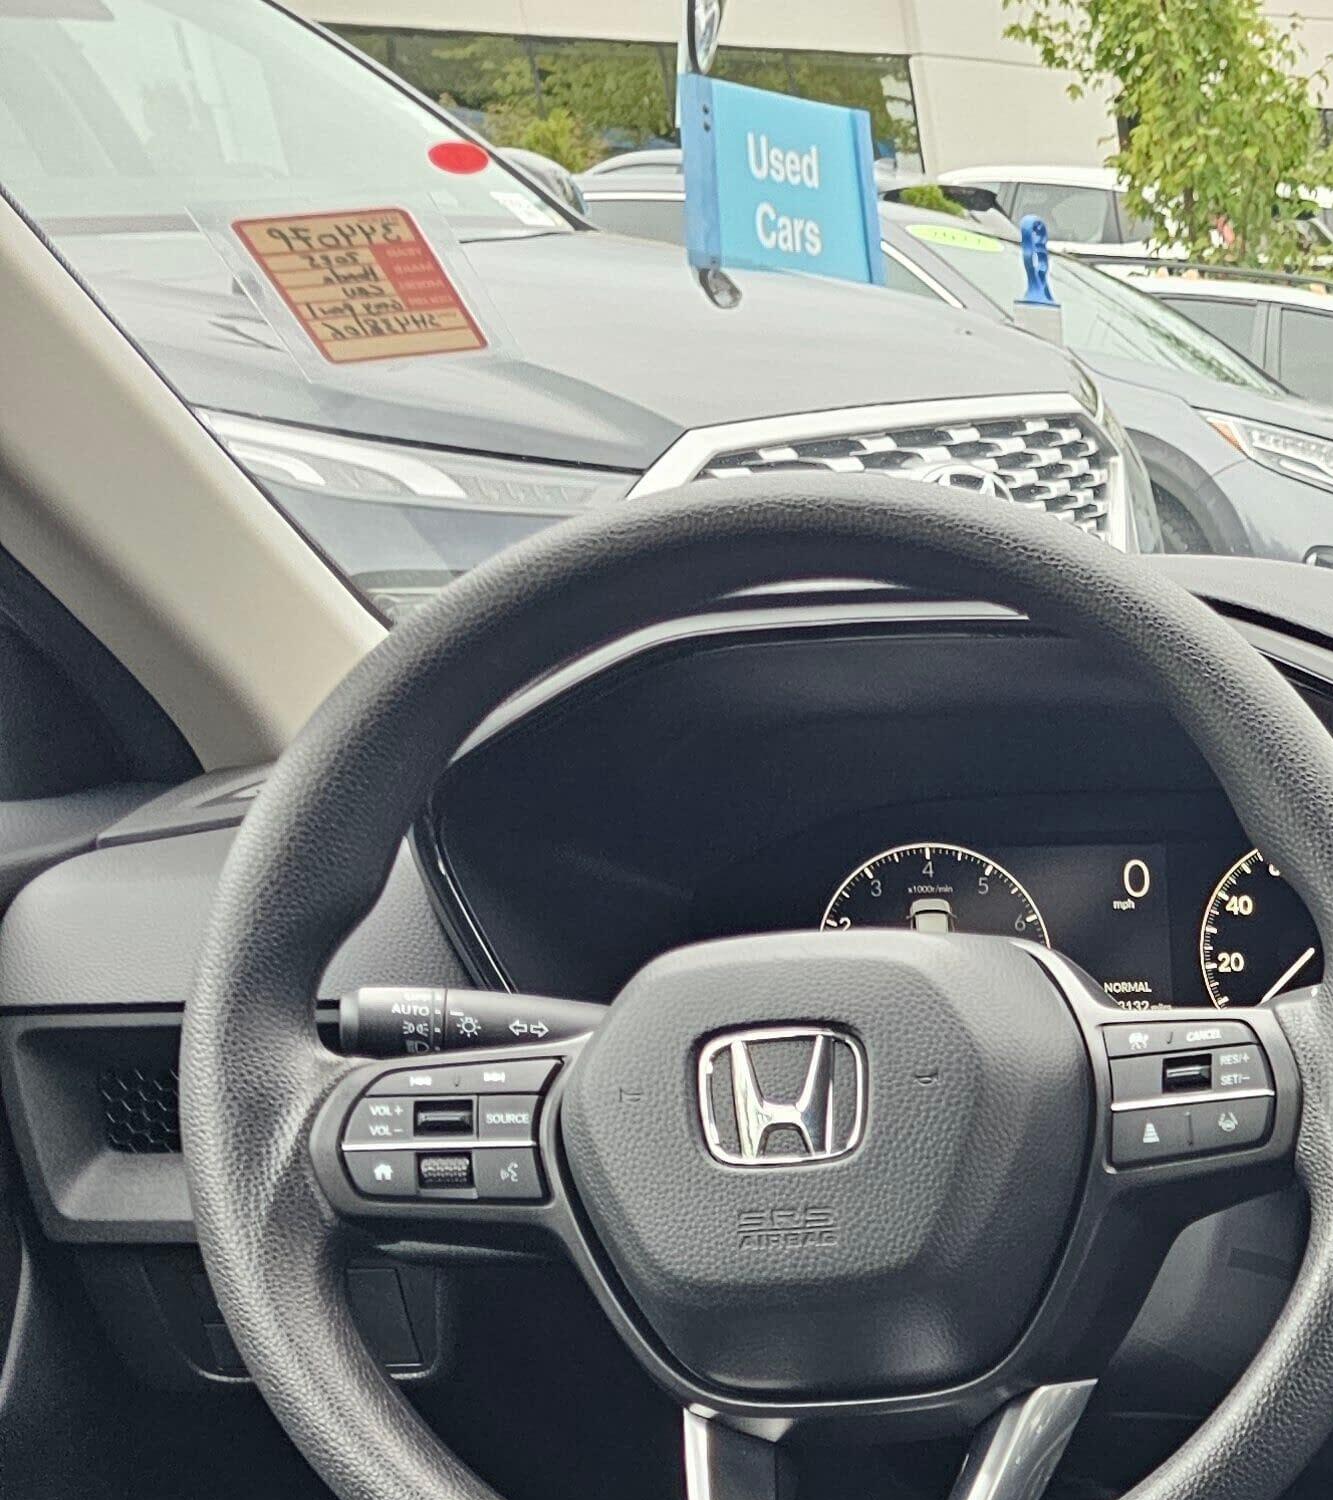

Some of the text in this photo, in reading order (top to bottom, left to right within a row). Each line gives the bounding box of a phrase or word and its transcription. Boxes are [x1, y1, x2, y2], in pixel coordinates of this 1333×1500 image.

[747, 131, 819, 189] Used
[755, 202, 822, 256] Cars
[922, 861, 934, 878] 4
[978, 877, 989, 895] 5
[1123, 859, 1151, 898] 0
[870, 880, 883, 897] 3
[1112, 898, 1136, 911] mph
[1225, 895, 1253, 916] 40
[1014, 914, 1026, 932] 6
[1218, 952, 1244, 973] 20
[1104, 982, 1152, 993] NORMAL
[391, 1002, 430, 1016] AUTO
[1185, 1029, 1222, 1042] CANCEL
[369, 1106, 392, 1116] VOL
[486, 1113, 529, 1124] SOURCE
[369, 1126, 392, 1137] VOL
